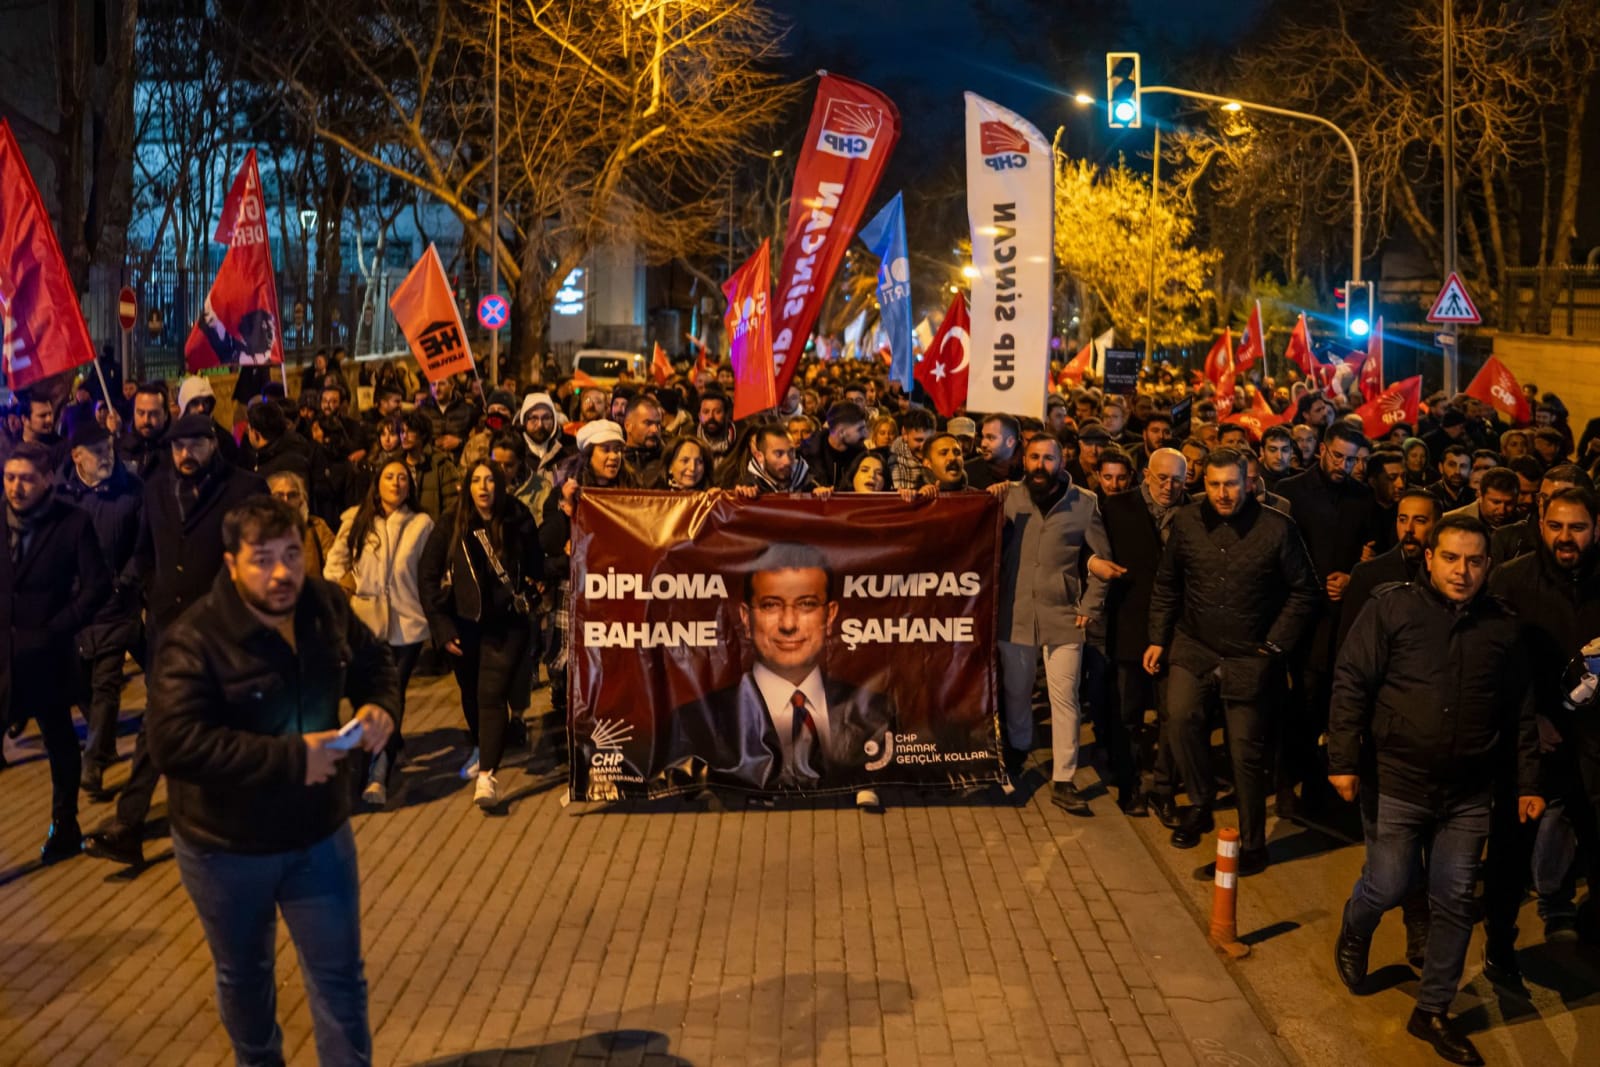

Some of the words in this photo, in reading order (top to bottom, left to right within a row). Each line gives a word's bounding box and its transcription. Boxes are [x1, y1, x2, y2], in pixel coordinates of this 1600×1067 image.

[584, 567, 728, 600] DİPLOMA
[843, 571, 981, 598] KUMPAS
[584, 621, 718, 648] BAHANE
[841, 617, 975, 650] ŞAHANE
[895, 734, 918, 743] CHP
[896, 744, 937, 753] MAMAK
[591, 753, 624, 766] CHP
[896, 752, 942, 765] GENÇLİK
[944, 750, 989, 762] KOLLARI
